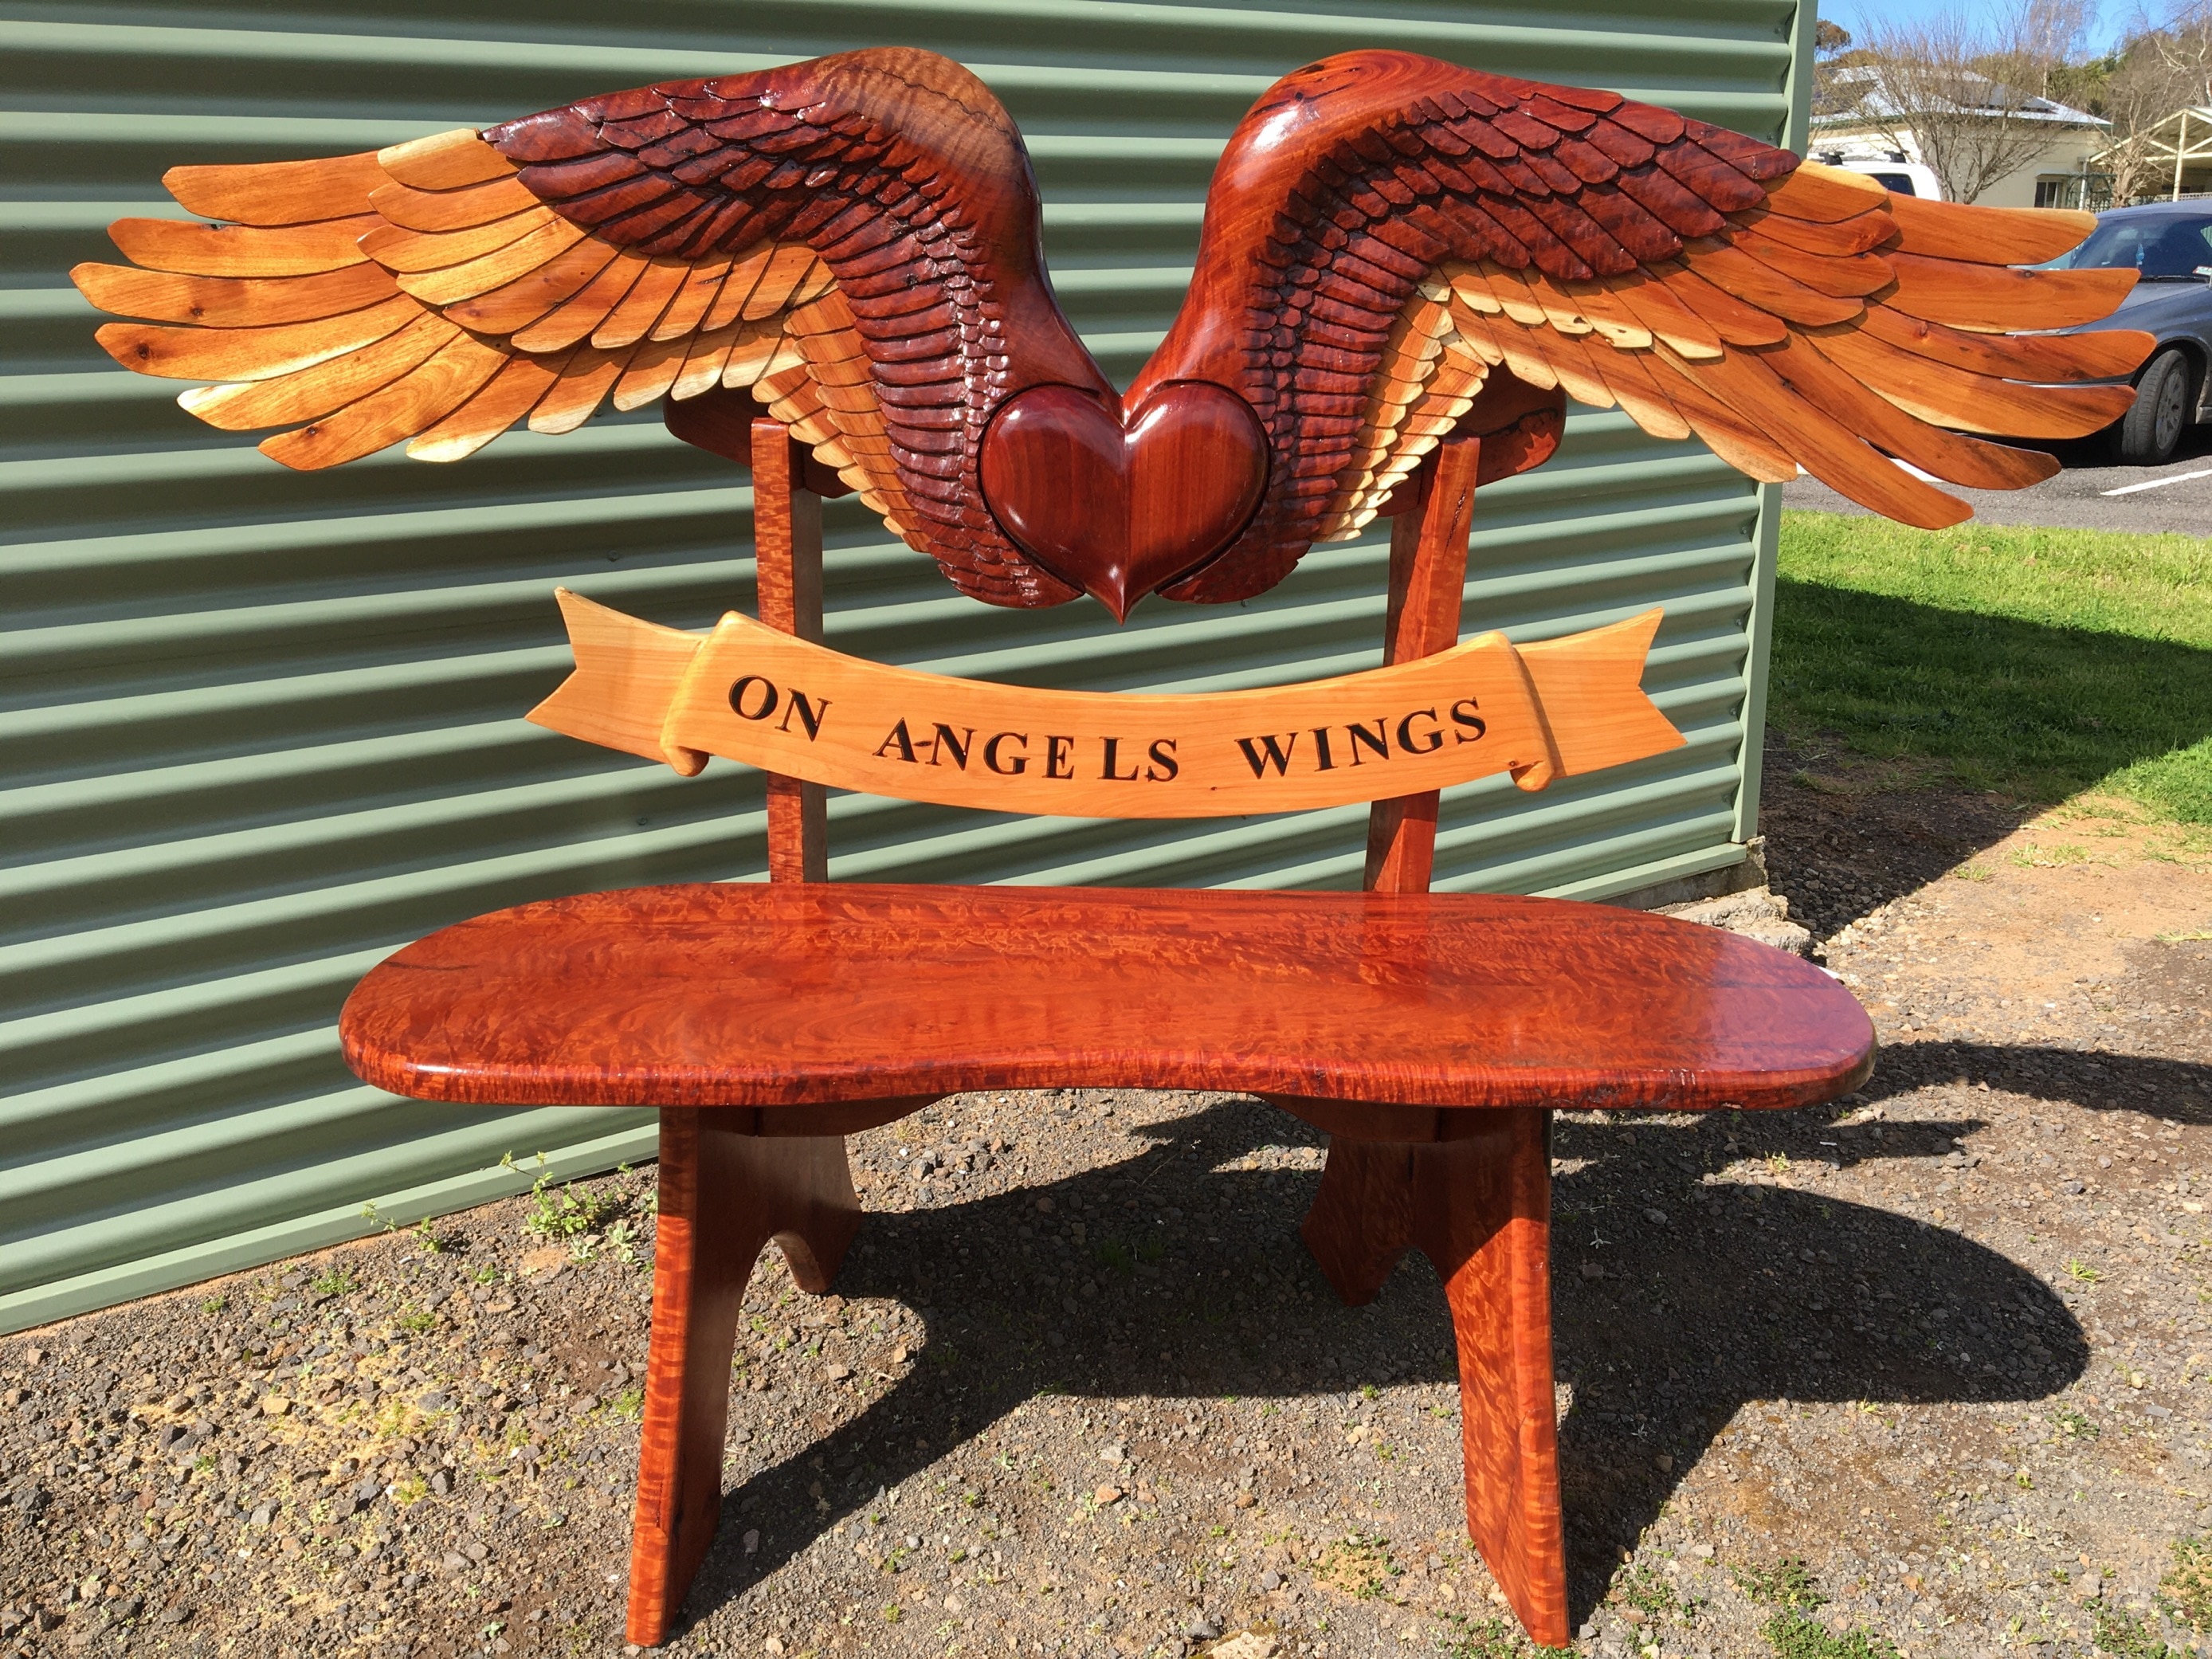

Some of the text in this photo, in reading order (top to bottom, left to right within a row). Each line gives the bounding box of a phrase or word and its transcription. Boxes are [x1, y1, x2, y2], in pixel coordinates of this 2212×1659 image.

[728, 675, 1487, 782] ON ANGELS WINGS
